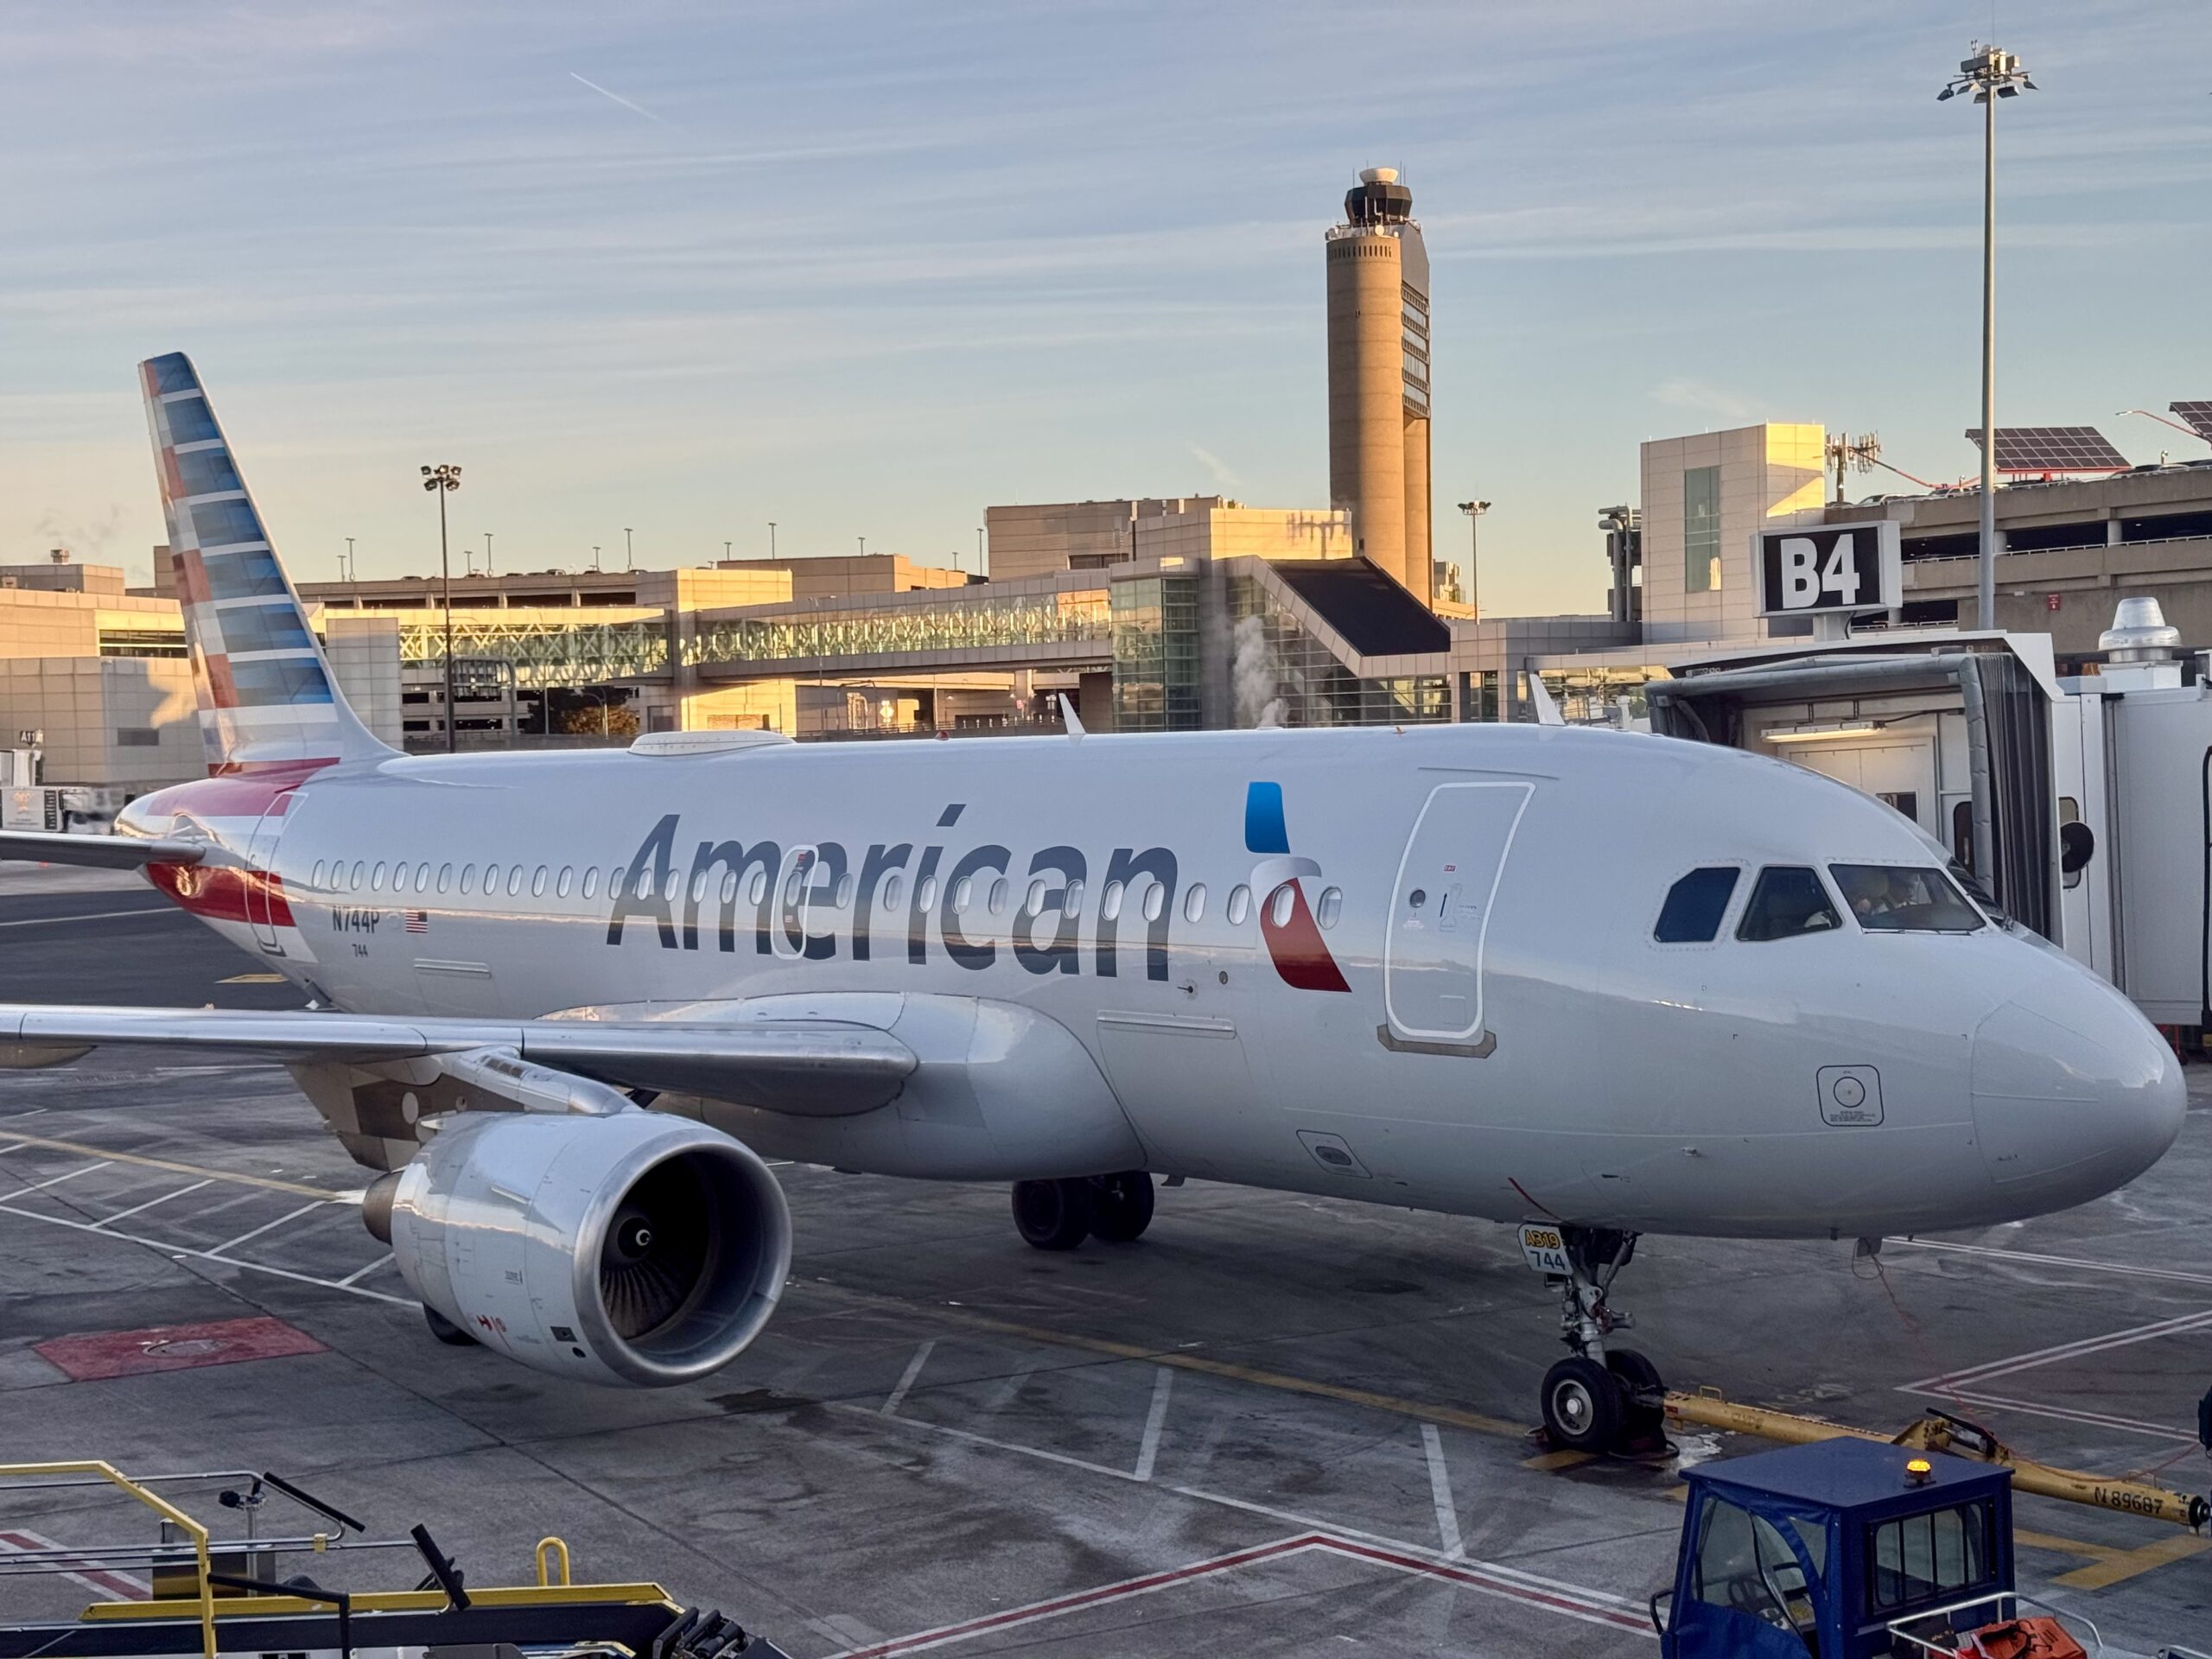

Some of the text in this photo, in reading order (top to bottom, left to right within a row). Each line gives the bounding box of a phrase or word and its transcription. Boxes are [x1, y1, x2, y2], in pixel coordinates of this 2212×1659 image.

[1780, 533, 1860, 609] B4
[607, 804, 1178, 982] American
[333, 906, 380, 933] N744P
[352, 944, 368, 957] 744
[1524, 1229, 1560, 1249] A319
[1529, 1250, 1566, 1270] 744
